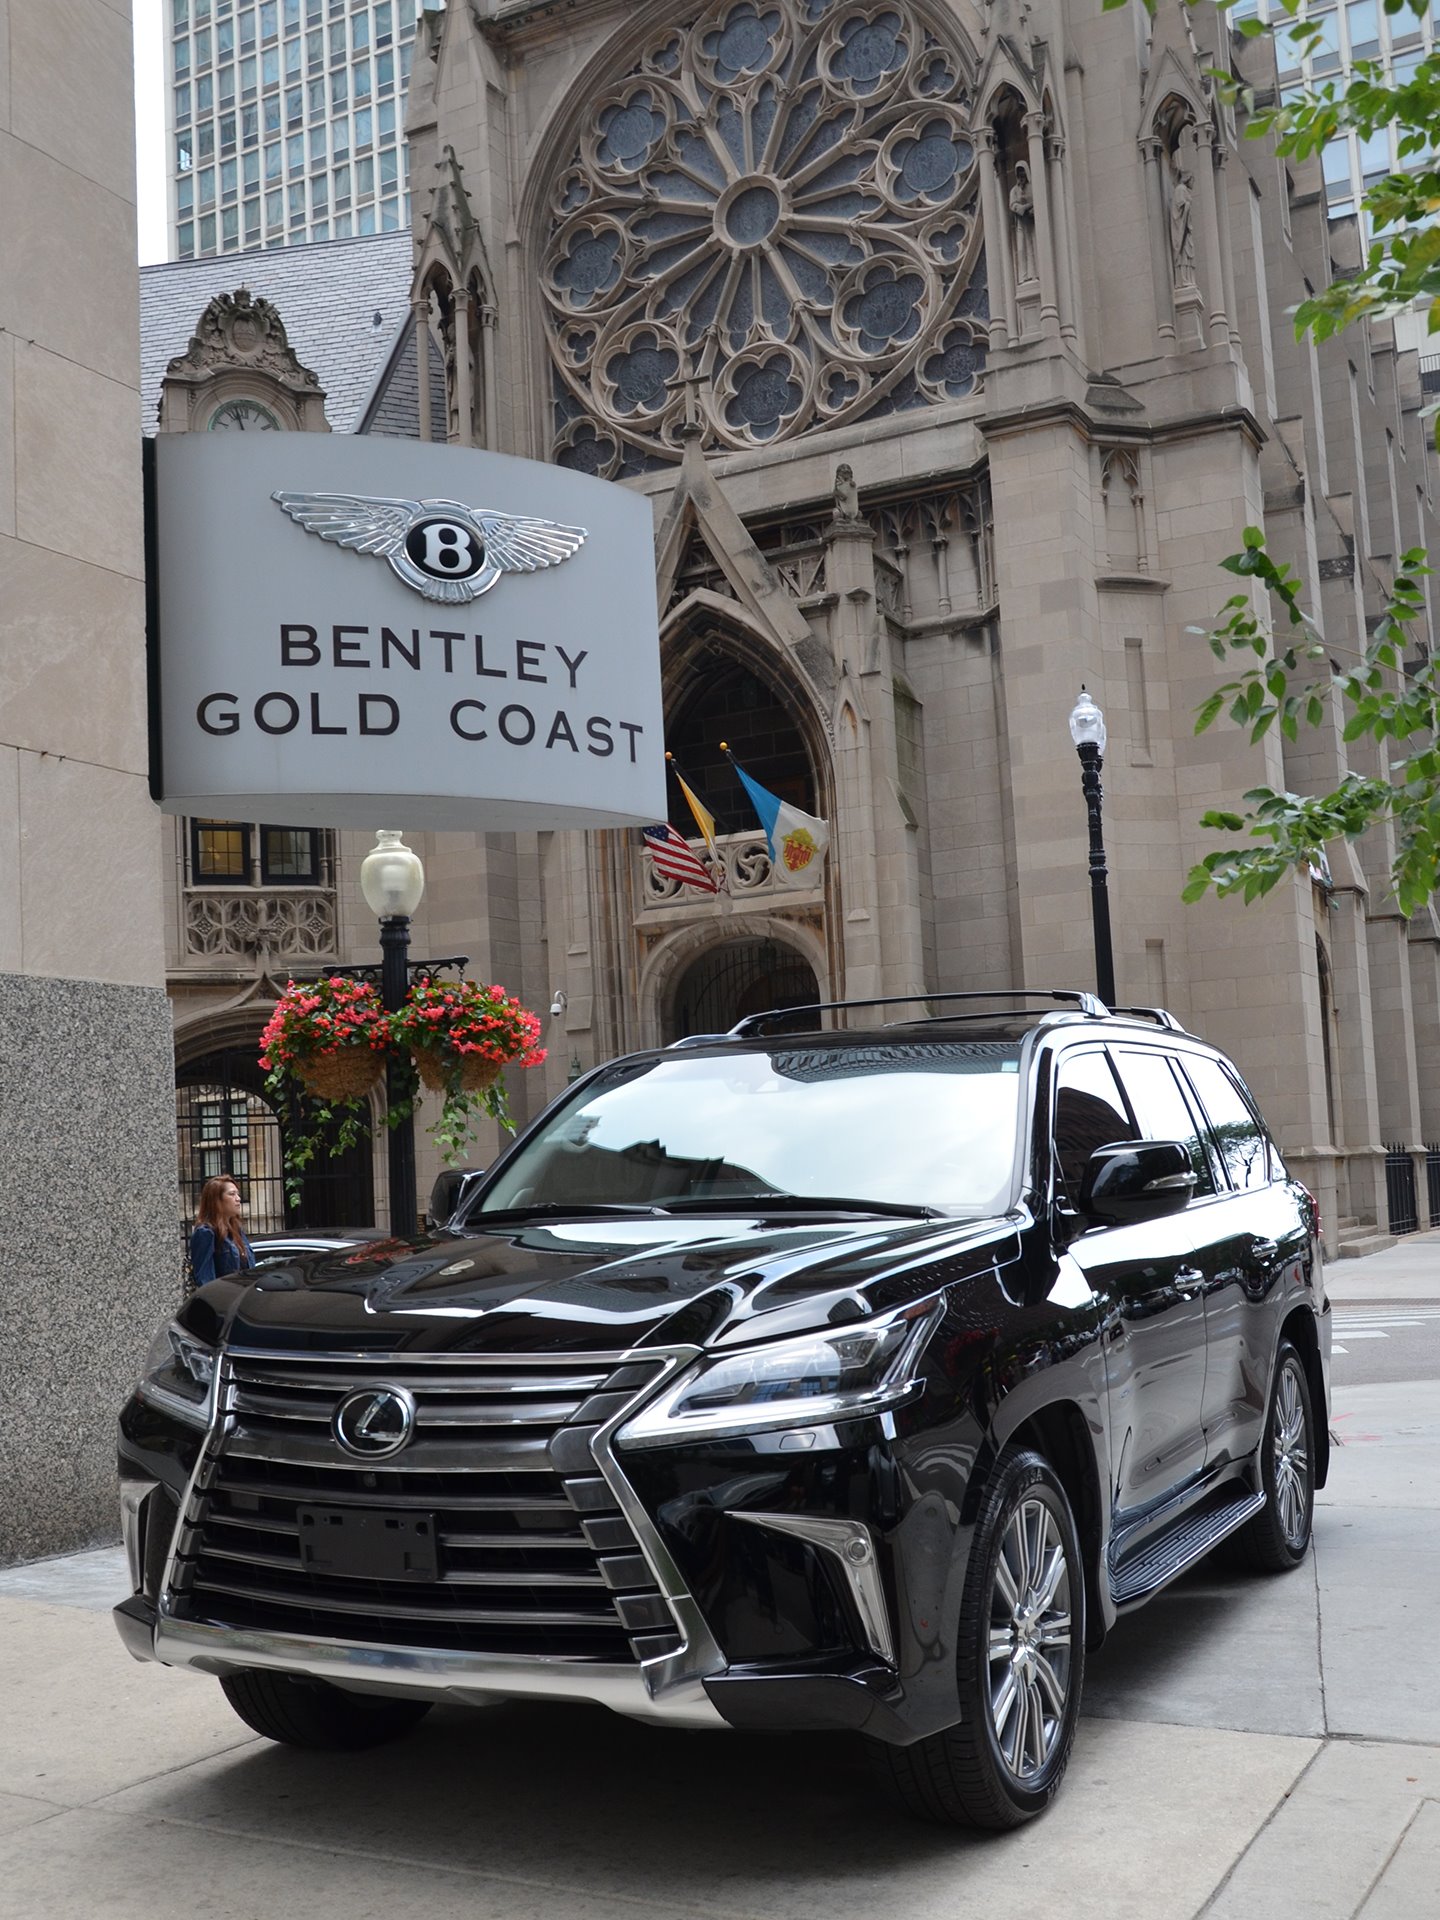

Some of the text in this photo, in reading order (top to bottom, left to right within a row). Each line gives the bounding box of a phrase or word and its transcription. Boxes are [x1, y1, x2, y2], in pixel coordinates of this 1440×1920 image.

[422, 523, 472, 573] B
[279, 623, 588, 688] BENTLEY
[195, 691, 643, 763] GOLD COAST
